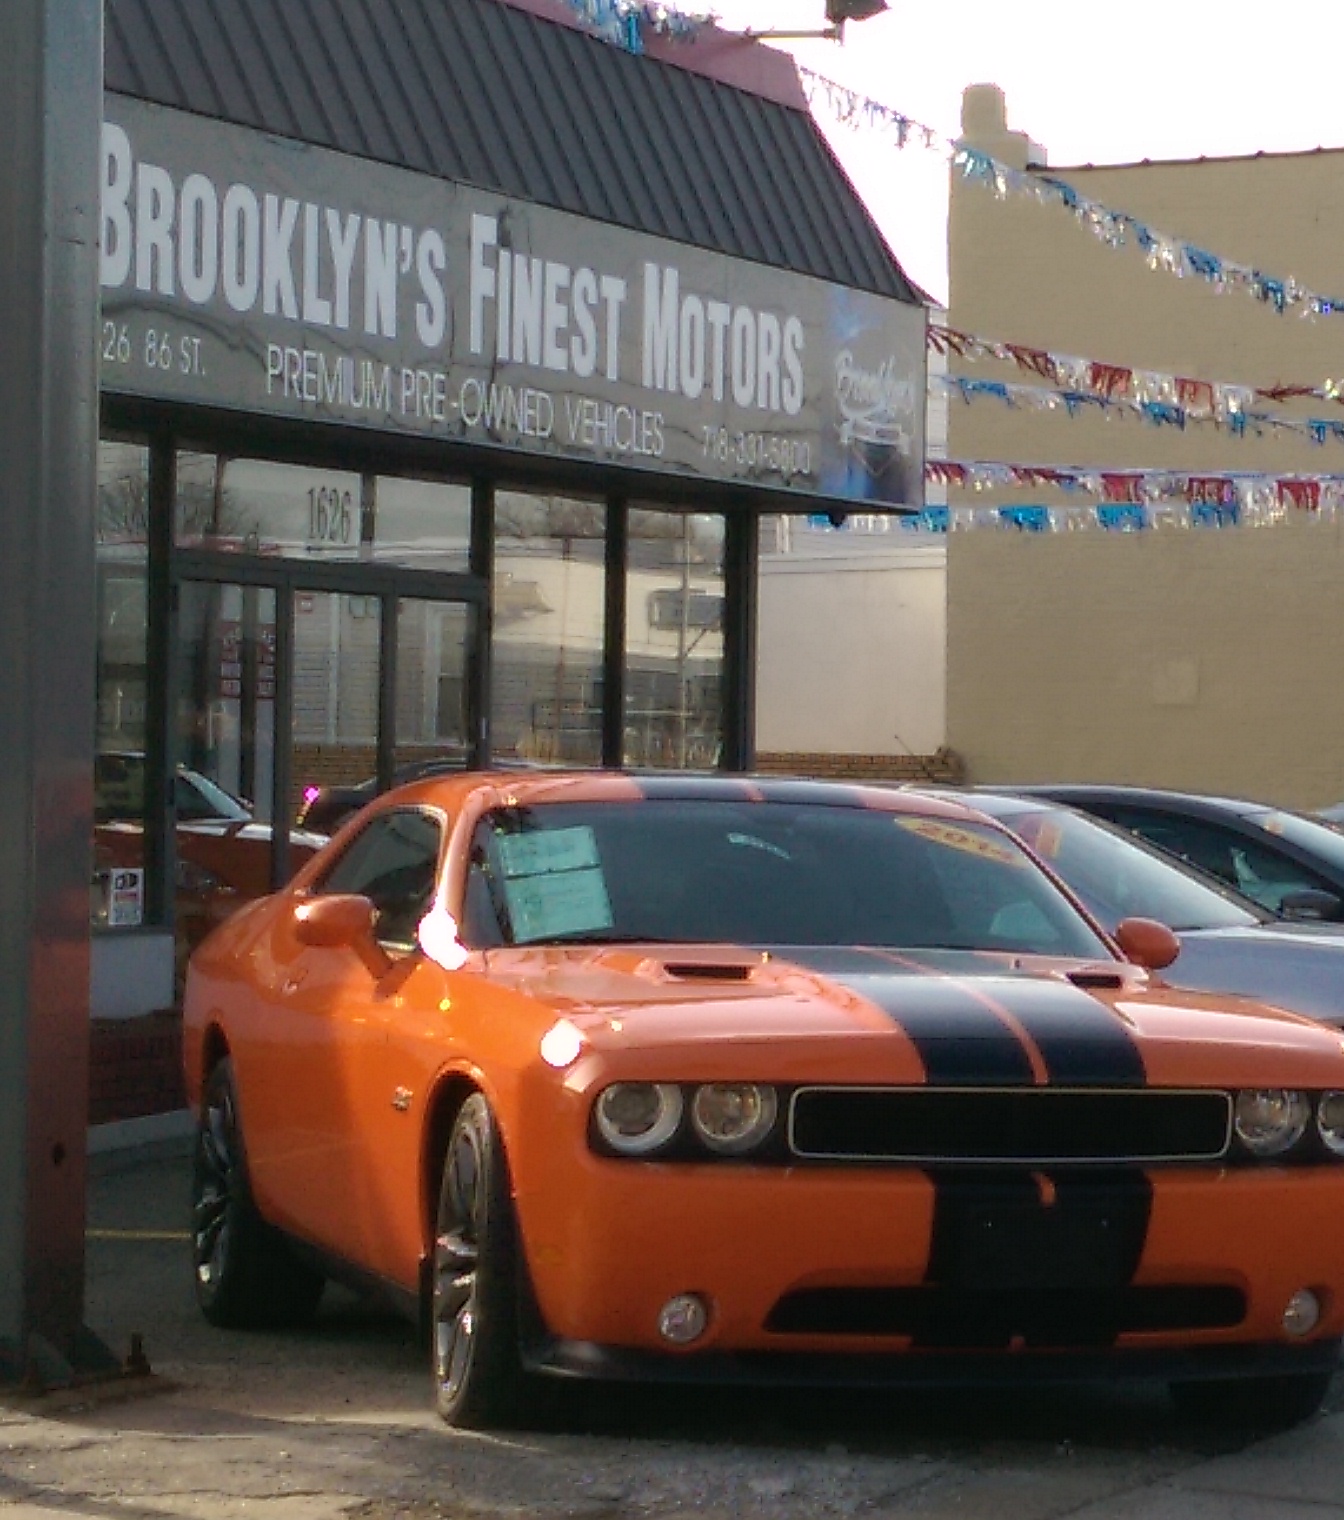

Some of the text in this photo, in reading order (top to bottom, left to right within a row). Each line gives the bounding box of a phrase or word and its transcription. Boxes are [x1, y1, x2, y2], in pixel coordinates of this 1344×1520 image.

[101, 121, 446, 347] BROOKLYN'S
[469, 212, 628, 382] FINEST
[641, 262, 805, 415] MOTORS
[102, 321, 206, 376] 26 86 ST.
[267, 343, 391, 412] PREMIUM
[565, 394, 665, 457] VEHICLES
[307, 485, 352, 544] 1626
